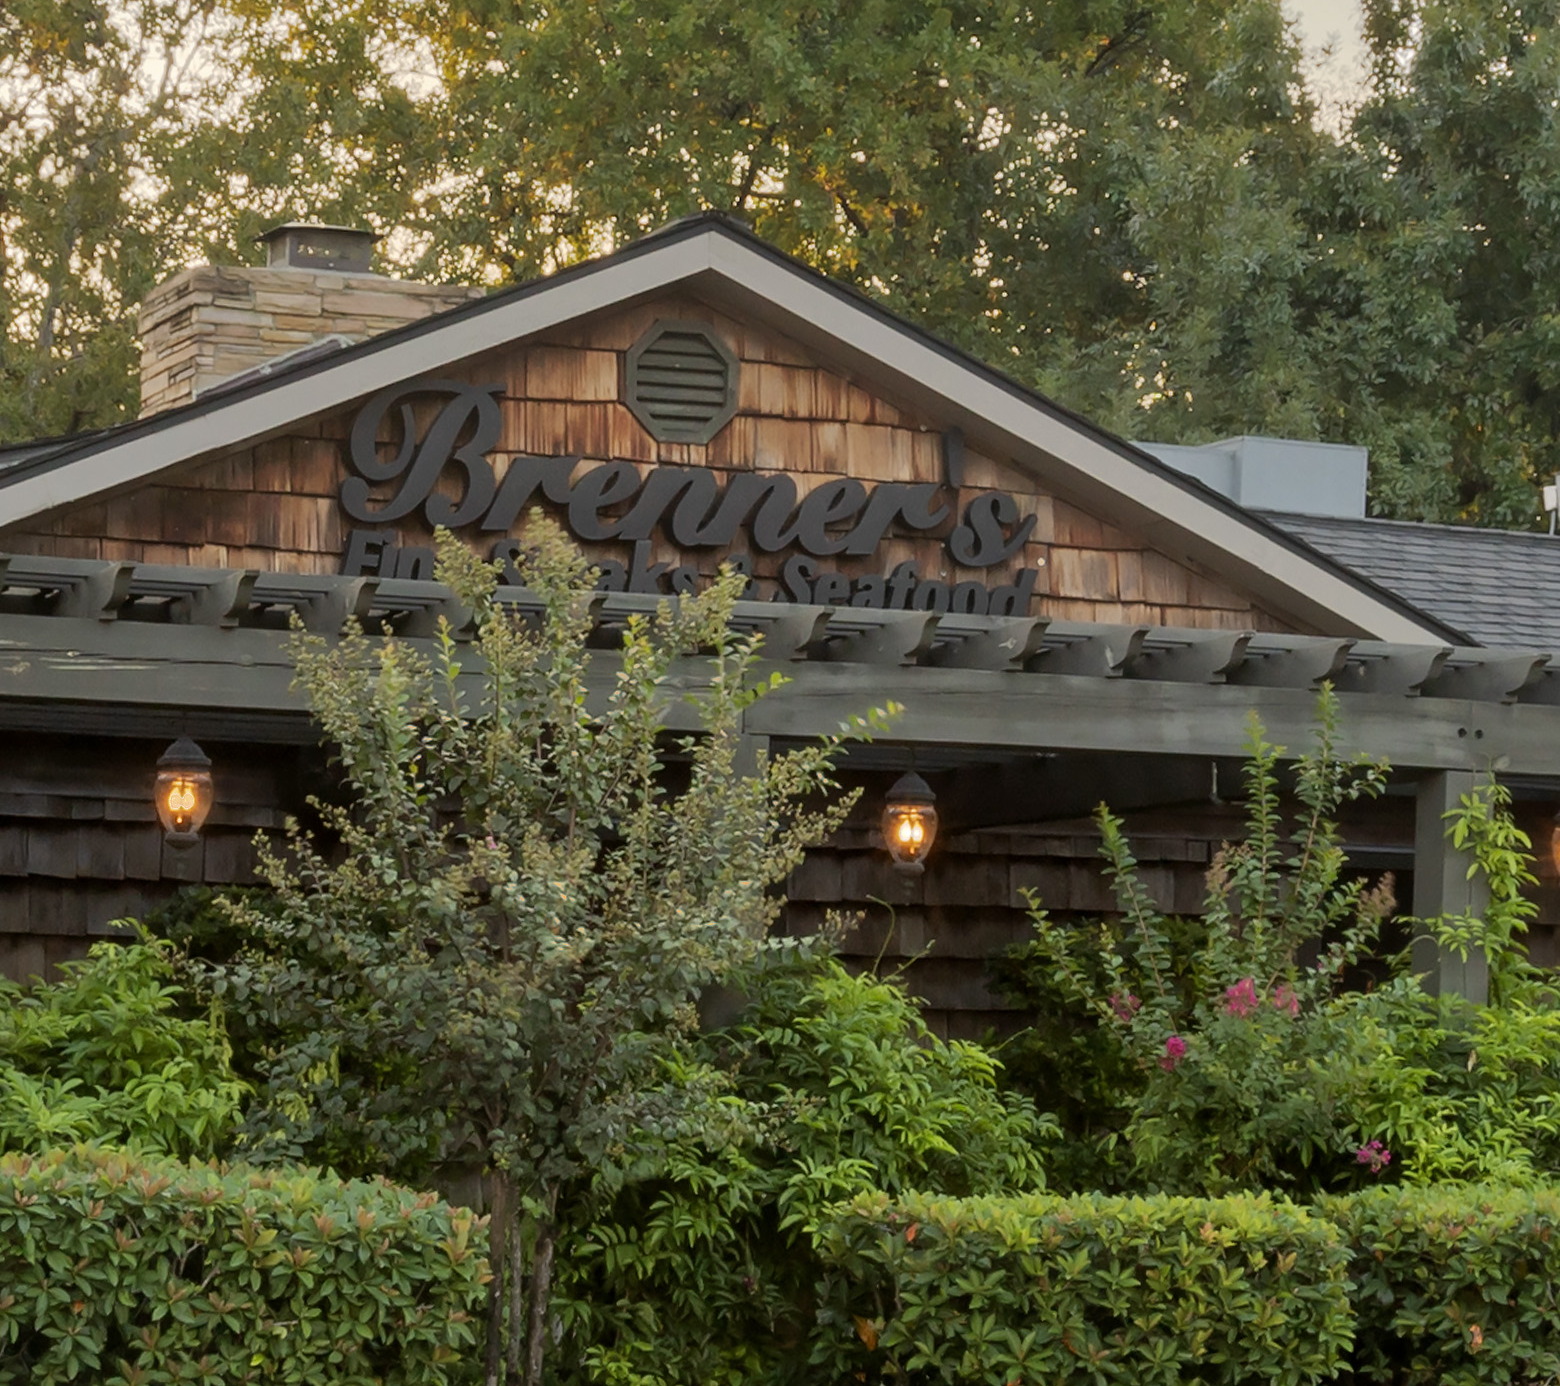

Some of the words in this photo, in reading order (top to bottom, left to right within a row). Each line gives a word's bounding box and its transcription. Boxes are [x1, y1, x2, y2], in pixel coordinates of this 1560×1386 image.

[338, 379, 1038, 568] Brenner's
[343, 529, 448, 583] Fin
[773, 553, 1038, 617] Seafood
